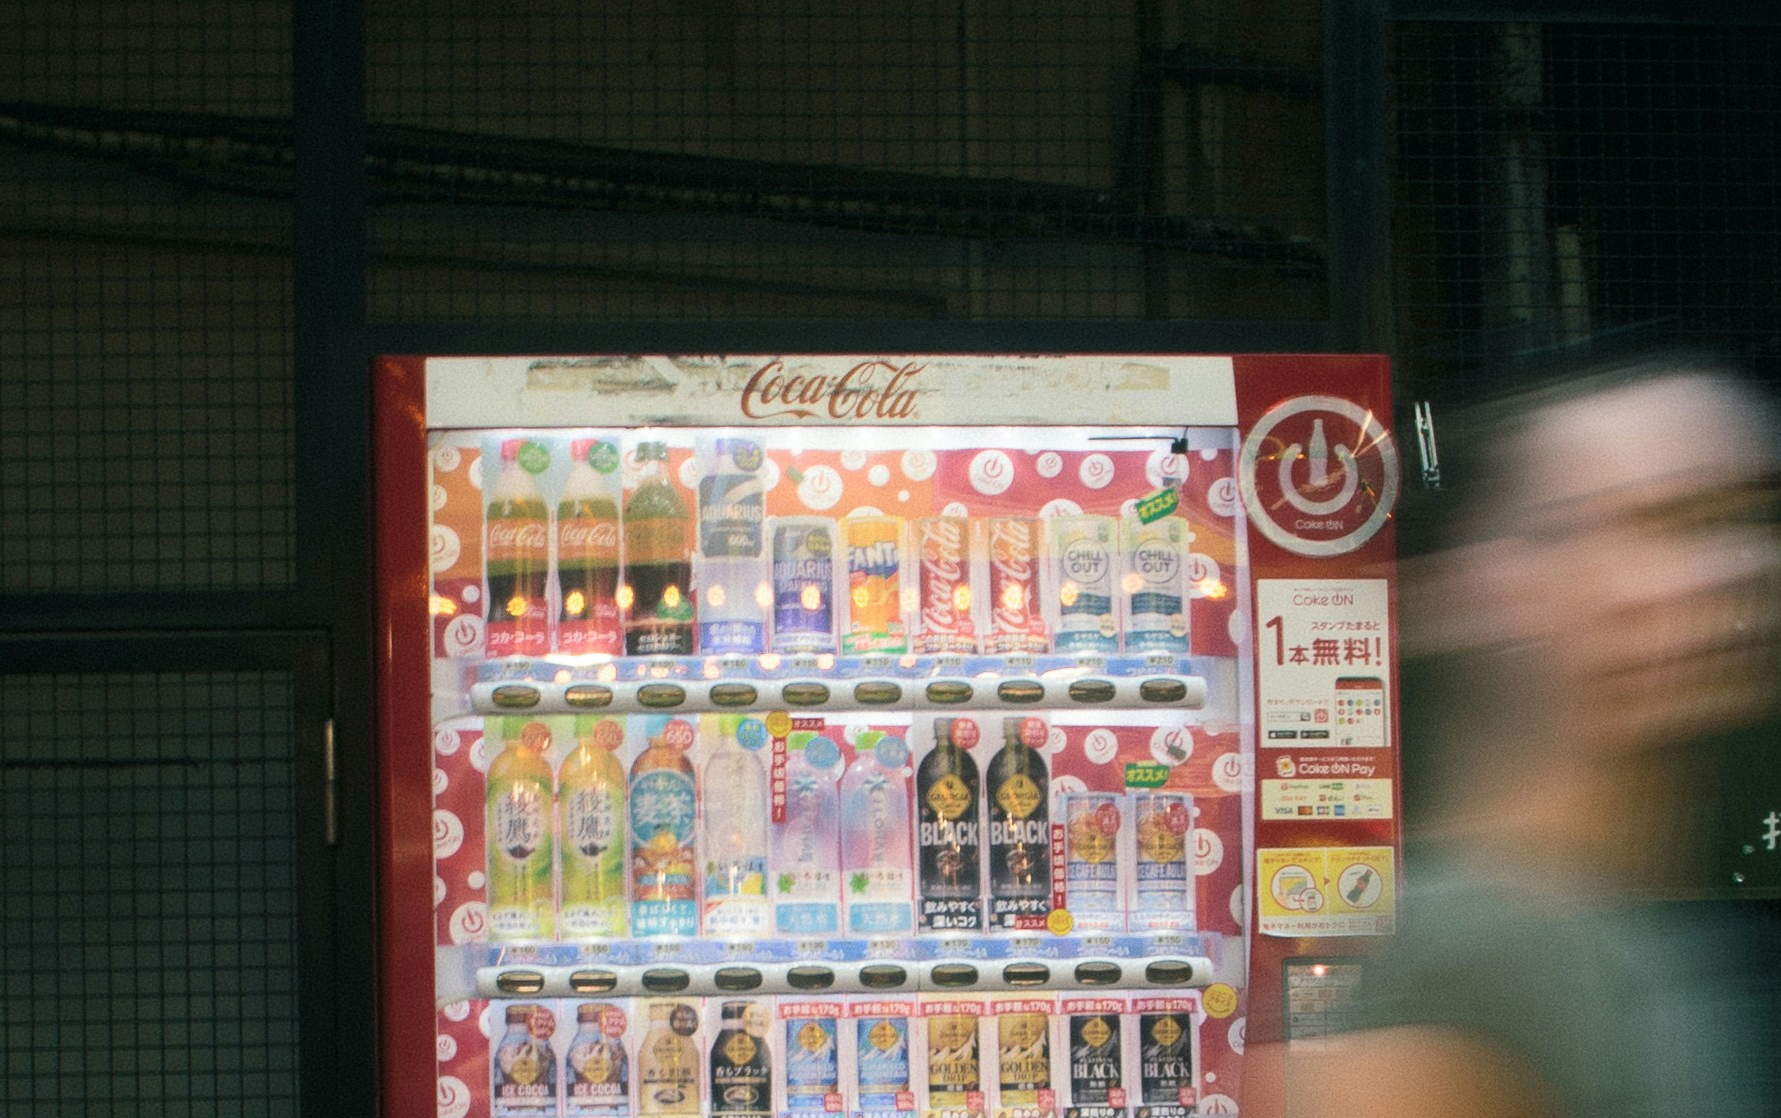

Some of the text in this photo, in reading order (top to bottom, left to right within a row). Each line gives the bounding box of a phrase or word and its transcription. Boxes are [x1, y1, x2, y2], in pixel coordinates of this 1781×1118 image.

[741, 361, 930, 419] Coca-Cola
[702, 504, 762, 522] AQUARIUS
[1295, 518, 1324, 530] Coke
[1069, 550, 1103, 562] CHILL
[1138, 549, 1174, 561] CHILL
[1071, 562, 1099, 573] OUT
[1142, 561, 1171, 573] OUT
[1293, 595, 1329, 606] Coke
[1311, 621, 1380, 631] スタンプたまると
[1265, 615, 1382, 666] 1本無料!
[1352, 763, 1376, 776] Pay
[921, 820, 978, 847] BLACK
[991, 820, 1049, 846] BLACK
[924, 900, 976, 913] 飲みやすく
[995, 900, 1047, 912] 飲みやすく
[930, 1063, 977, 1073] GOLDEN
[1000, 1062, 1047, 1072] GOLDEN
[1074, 1063, 1119, 1079] BLACK
[1144, 1062, 1190, 1078] BLACK
[519, 1084, 549, 1096] COCOA
[591, 1083, 622, 1095] COCOA
